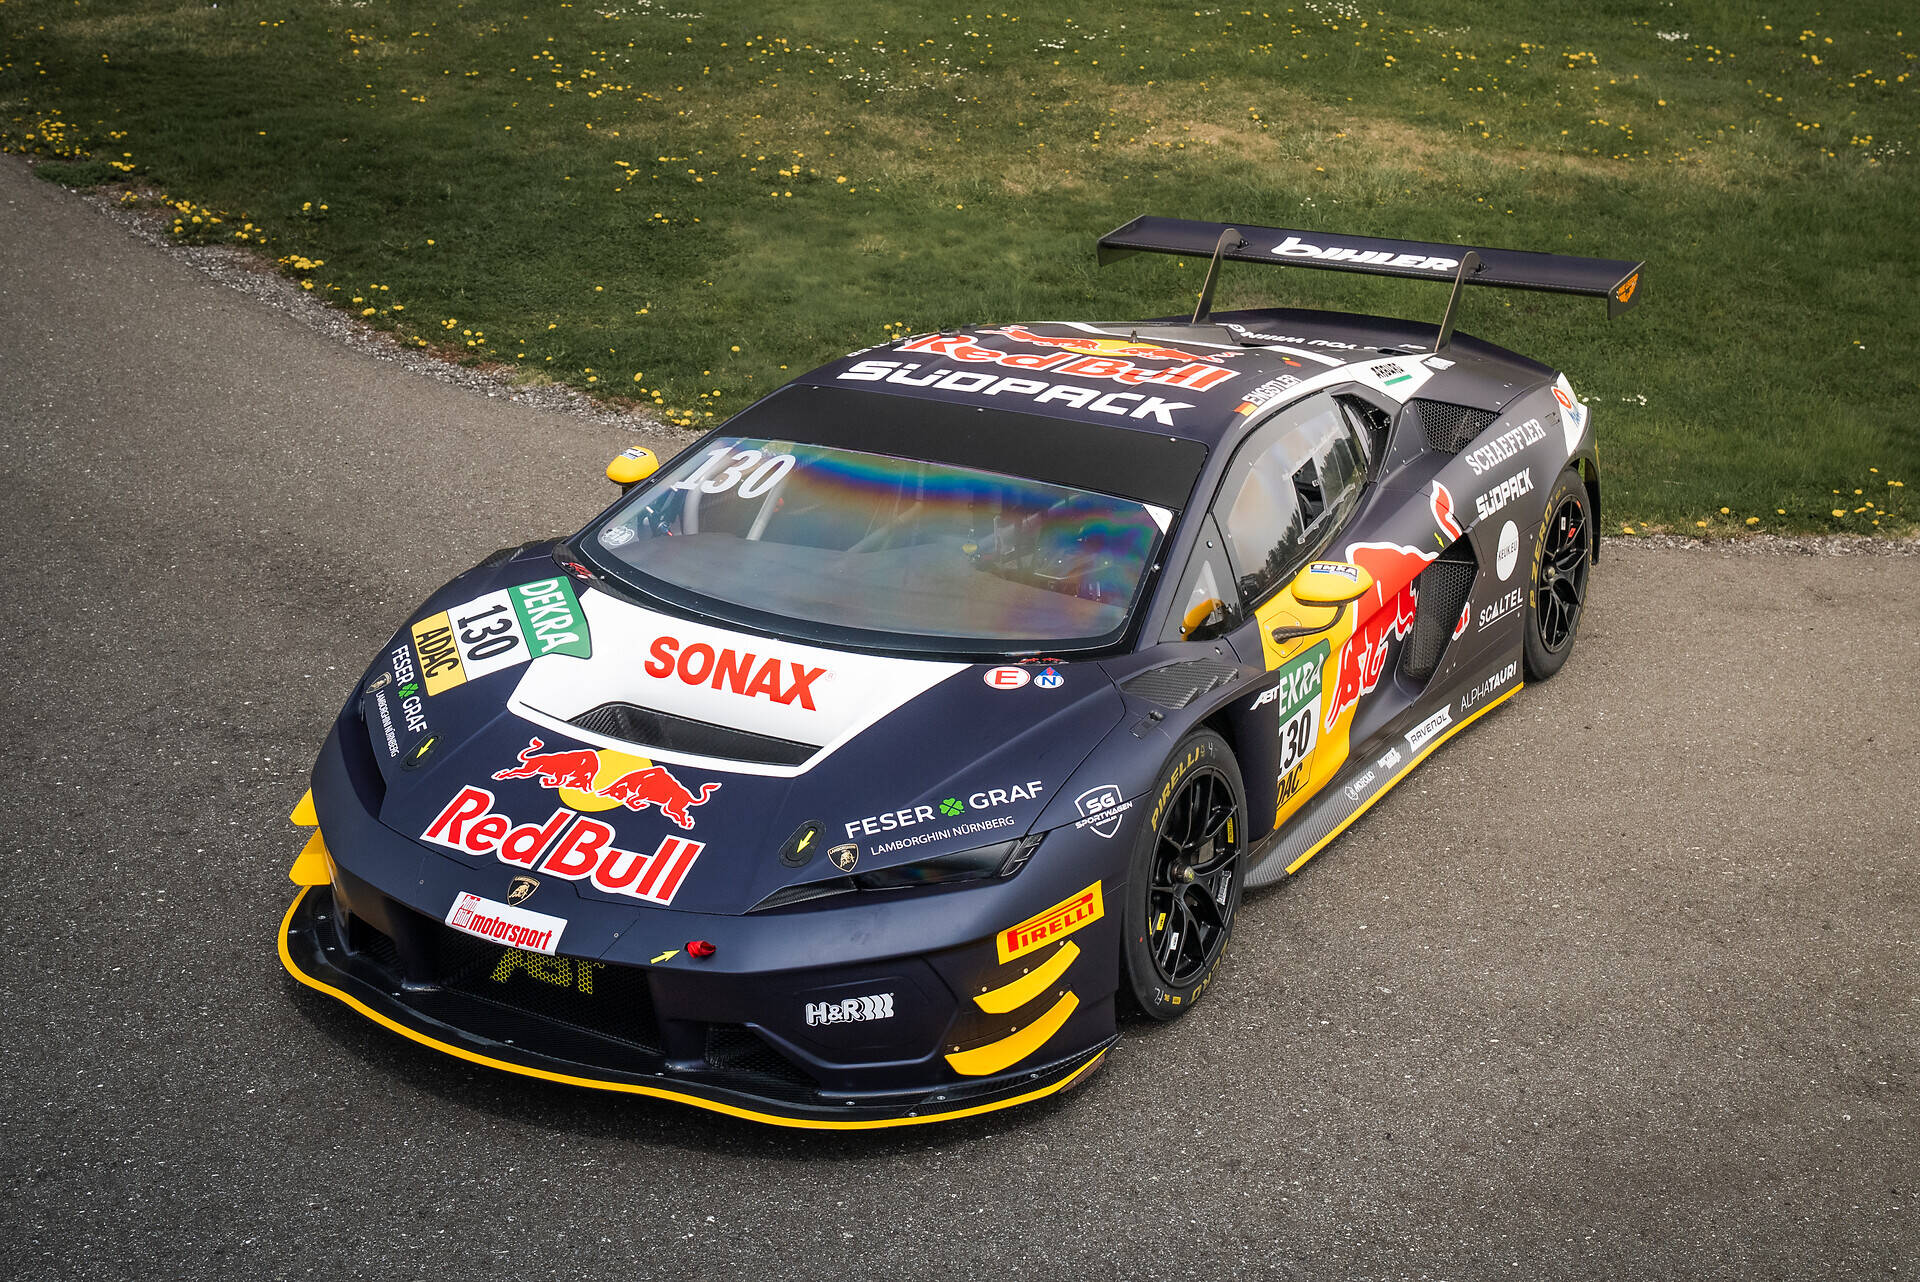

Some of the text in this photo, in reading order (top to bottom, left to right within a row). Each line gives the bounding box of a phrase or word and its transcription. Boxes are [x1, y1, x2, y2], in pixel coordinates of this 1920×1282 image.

[893, 333, 1061, 374] Red
[1052, 355, 1242, 392] Bull
[837, 360, 1197, 427] SÜDPACK
[674, 445, 796, 499] 130
[1465, 418, 1546, 475] SCHAEFFLER
[1475, 466, 1535, 521] SÜDPACK
[458, 604, 520, 660] 130
[519, 579, 580, 654] DEKRA
[1478, 587, 1524, 627] SCALTEL
[416, 625, 460, 679] ADAC
[644, 636, 828, 711] SONAX
[392, 644, 428, 733] FESER GRAF
[1250, 685, 1279, 710] ABT
[1279, 653, 1325, 718] EKRA
[1461, 660, 1518, 712] ALPHATAURI
[1410, 712, 1448, 746] RAVENOL
[845, 780, 1044, 839] FESER GRAF
[1075, 801, 1133, 829] SPORTWAGEN
[1086, 792, 1116, 815] SG
[1151, 746, 1200, 832] PIRELLI
[420, 785, 706, 906] Red Bull
[871, 829, 950, 856] LAMBORGHINI
[952, 815, 1015, 837] NÜRNBERG
[468, 913, 553, 950] motorsport
[1007, 892, 1094, 953] PIRELLI
[805, 998, 866, 1027] H&R
